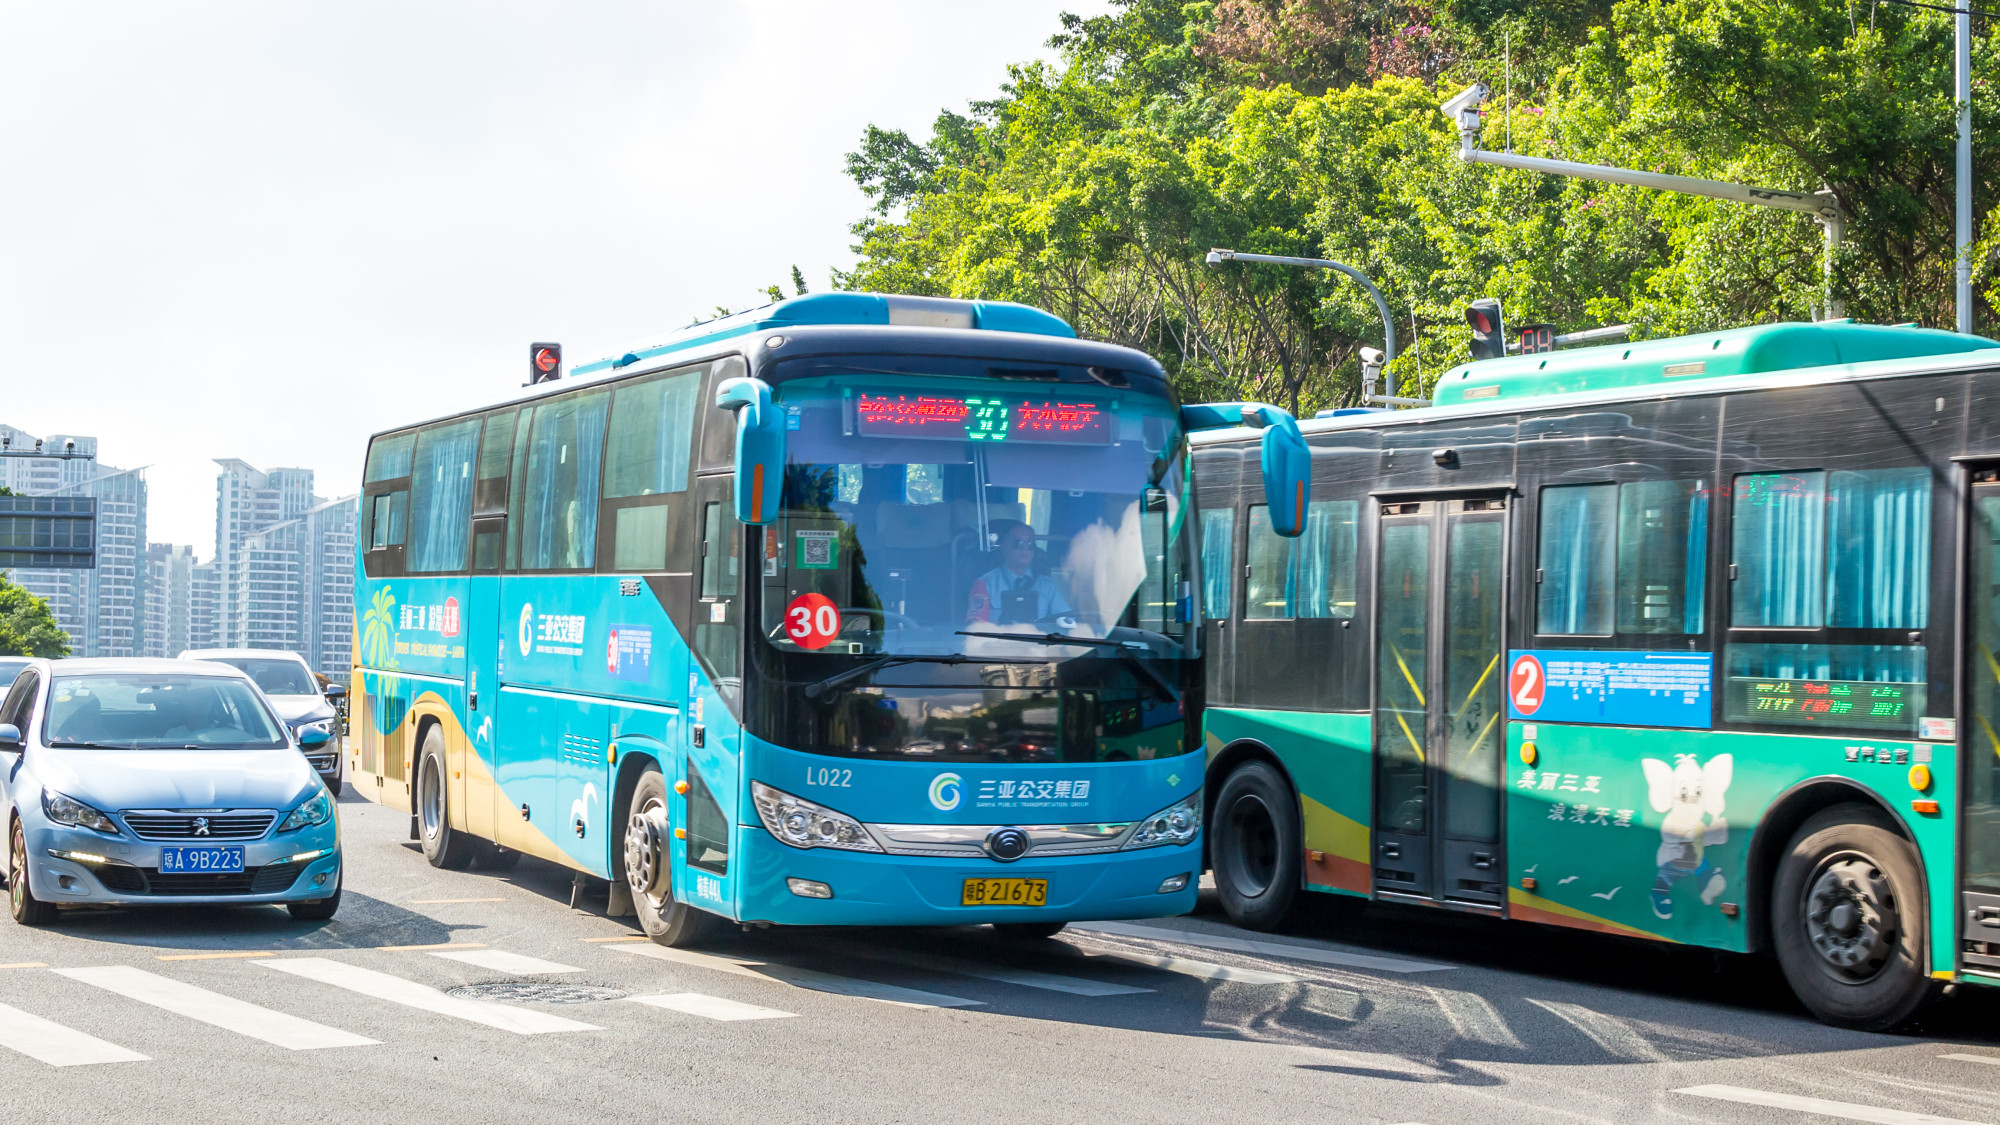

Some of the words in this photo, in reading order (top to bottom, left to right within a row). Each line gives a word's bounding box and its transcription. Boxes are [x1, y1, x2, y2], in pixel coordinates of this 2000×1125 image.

[537, 614, 585, 644] 三亚公交集团
[790, 606, 837, 638] 30
[607, 635, 618, 668] 30
[1516, 661, 1538, 706] 2
[807, 766, 852, 788] L022
[978, 780, 1090, 799] 三亚公交集团
[1516, 769, 1603, 794] 美丽三亚
[1547, 802, 1634, 827] 浪漫天涯
